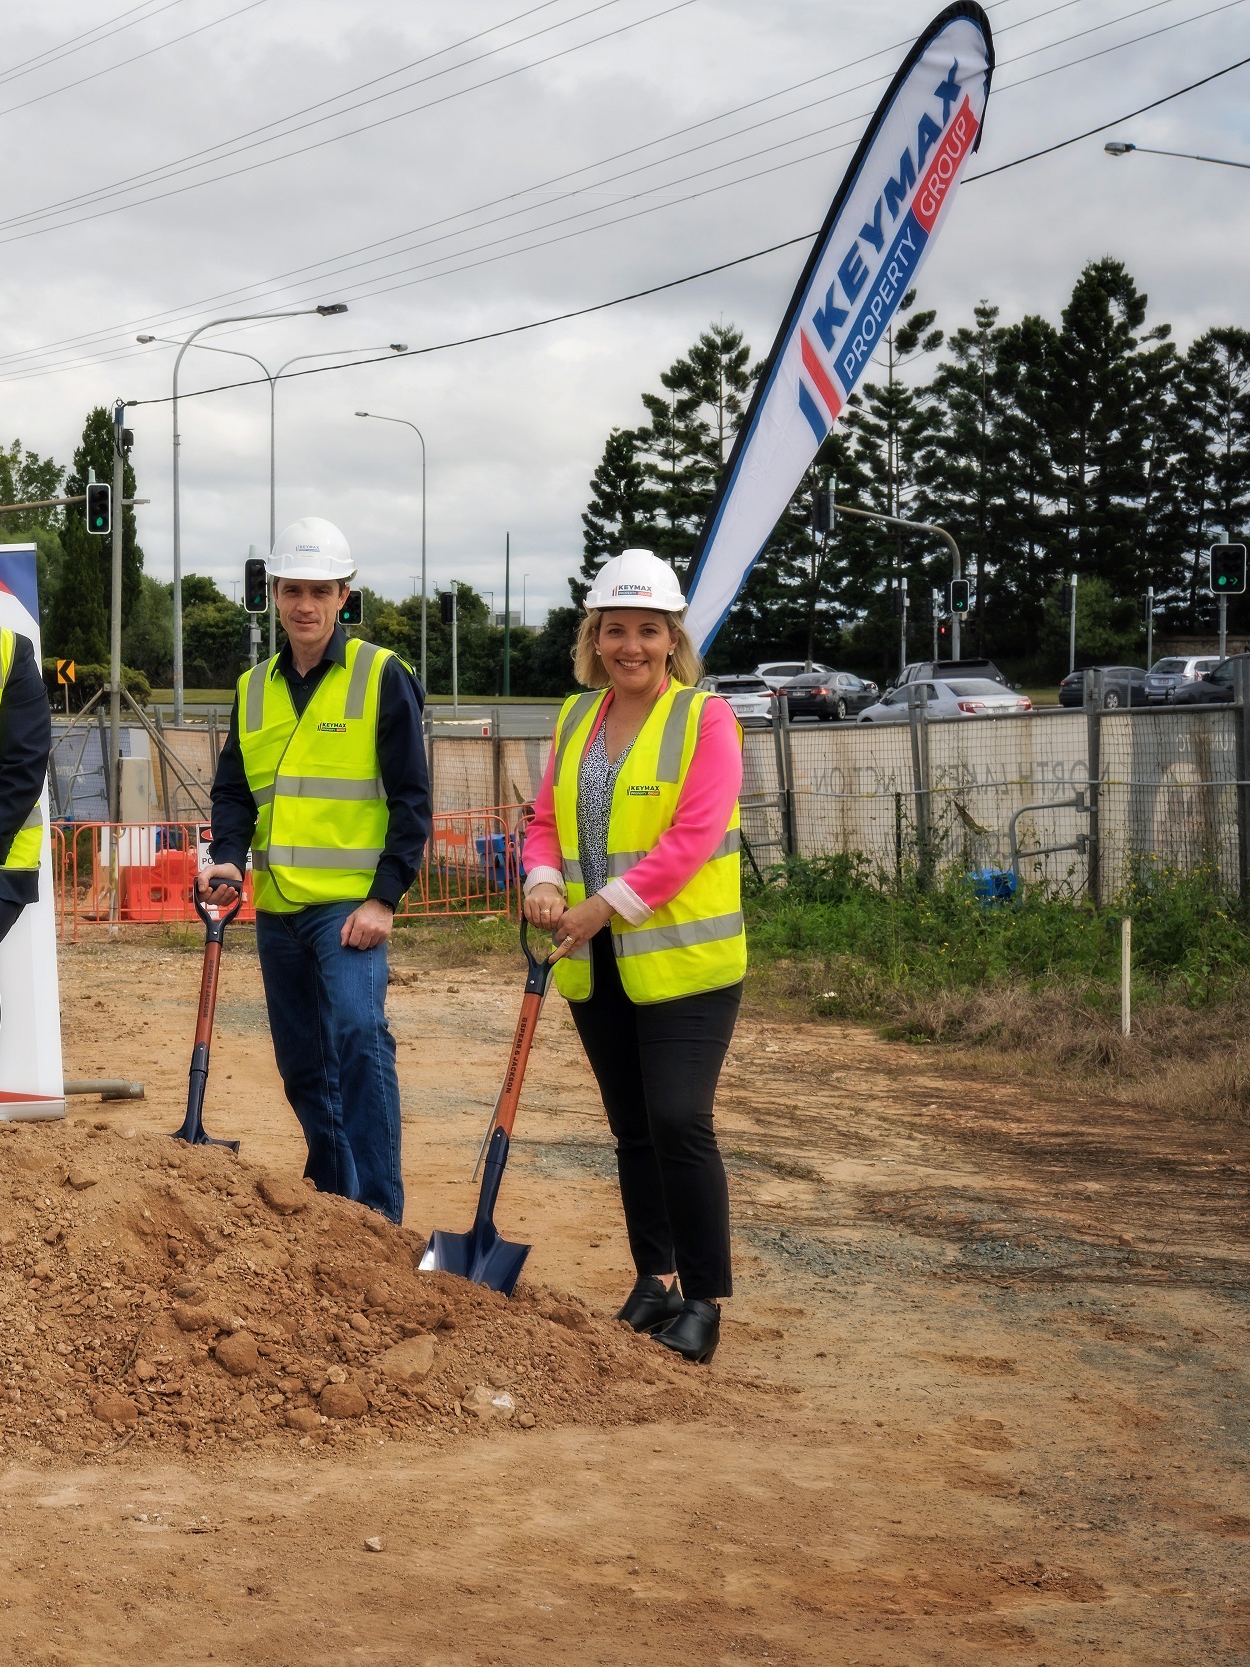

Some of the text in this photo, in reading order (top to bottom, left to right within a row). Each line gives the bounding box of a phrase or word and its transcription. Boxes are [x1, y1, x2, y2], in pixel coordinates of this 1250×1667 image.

[812, 57, 961, 352] KEYMAX
[843, 116, 967, 380] PROPERTY GROUP
[505, 1057, 518, 1094] JACKSON
[516, 1023, 527, 1049] SPEAR
